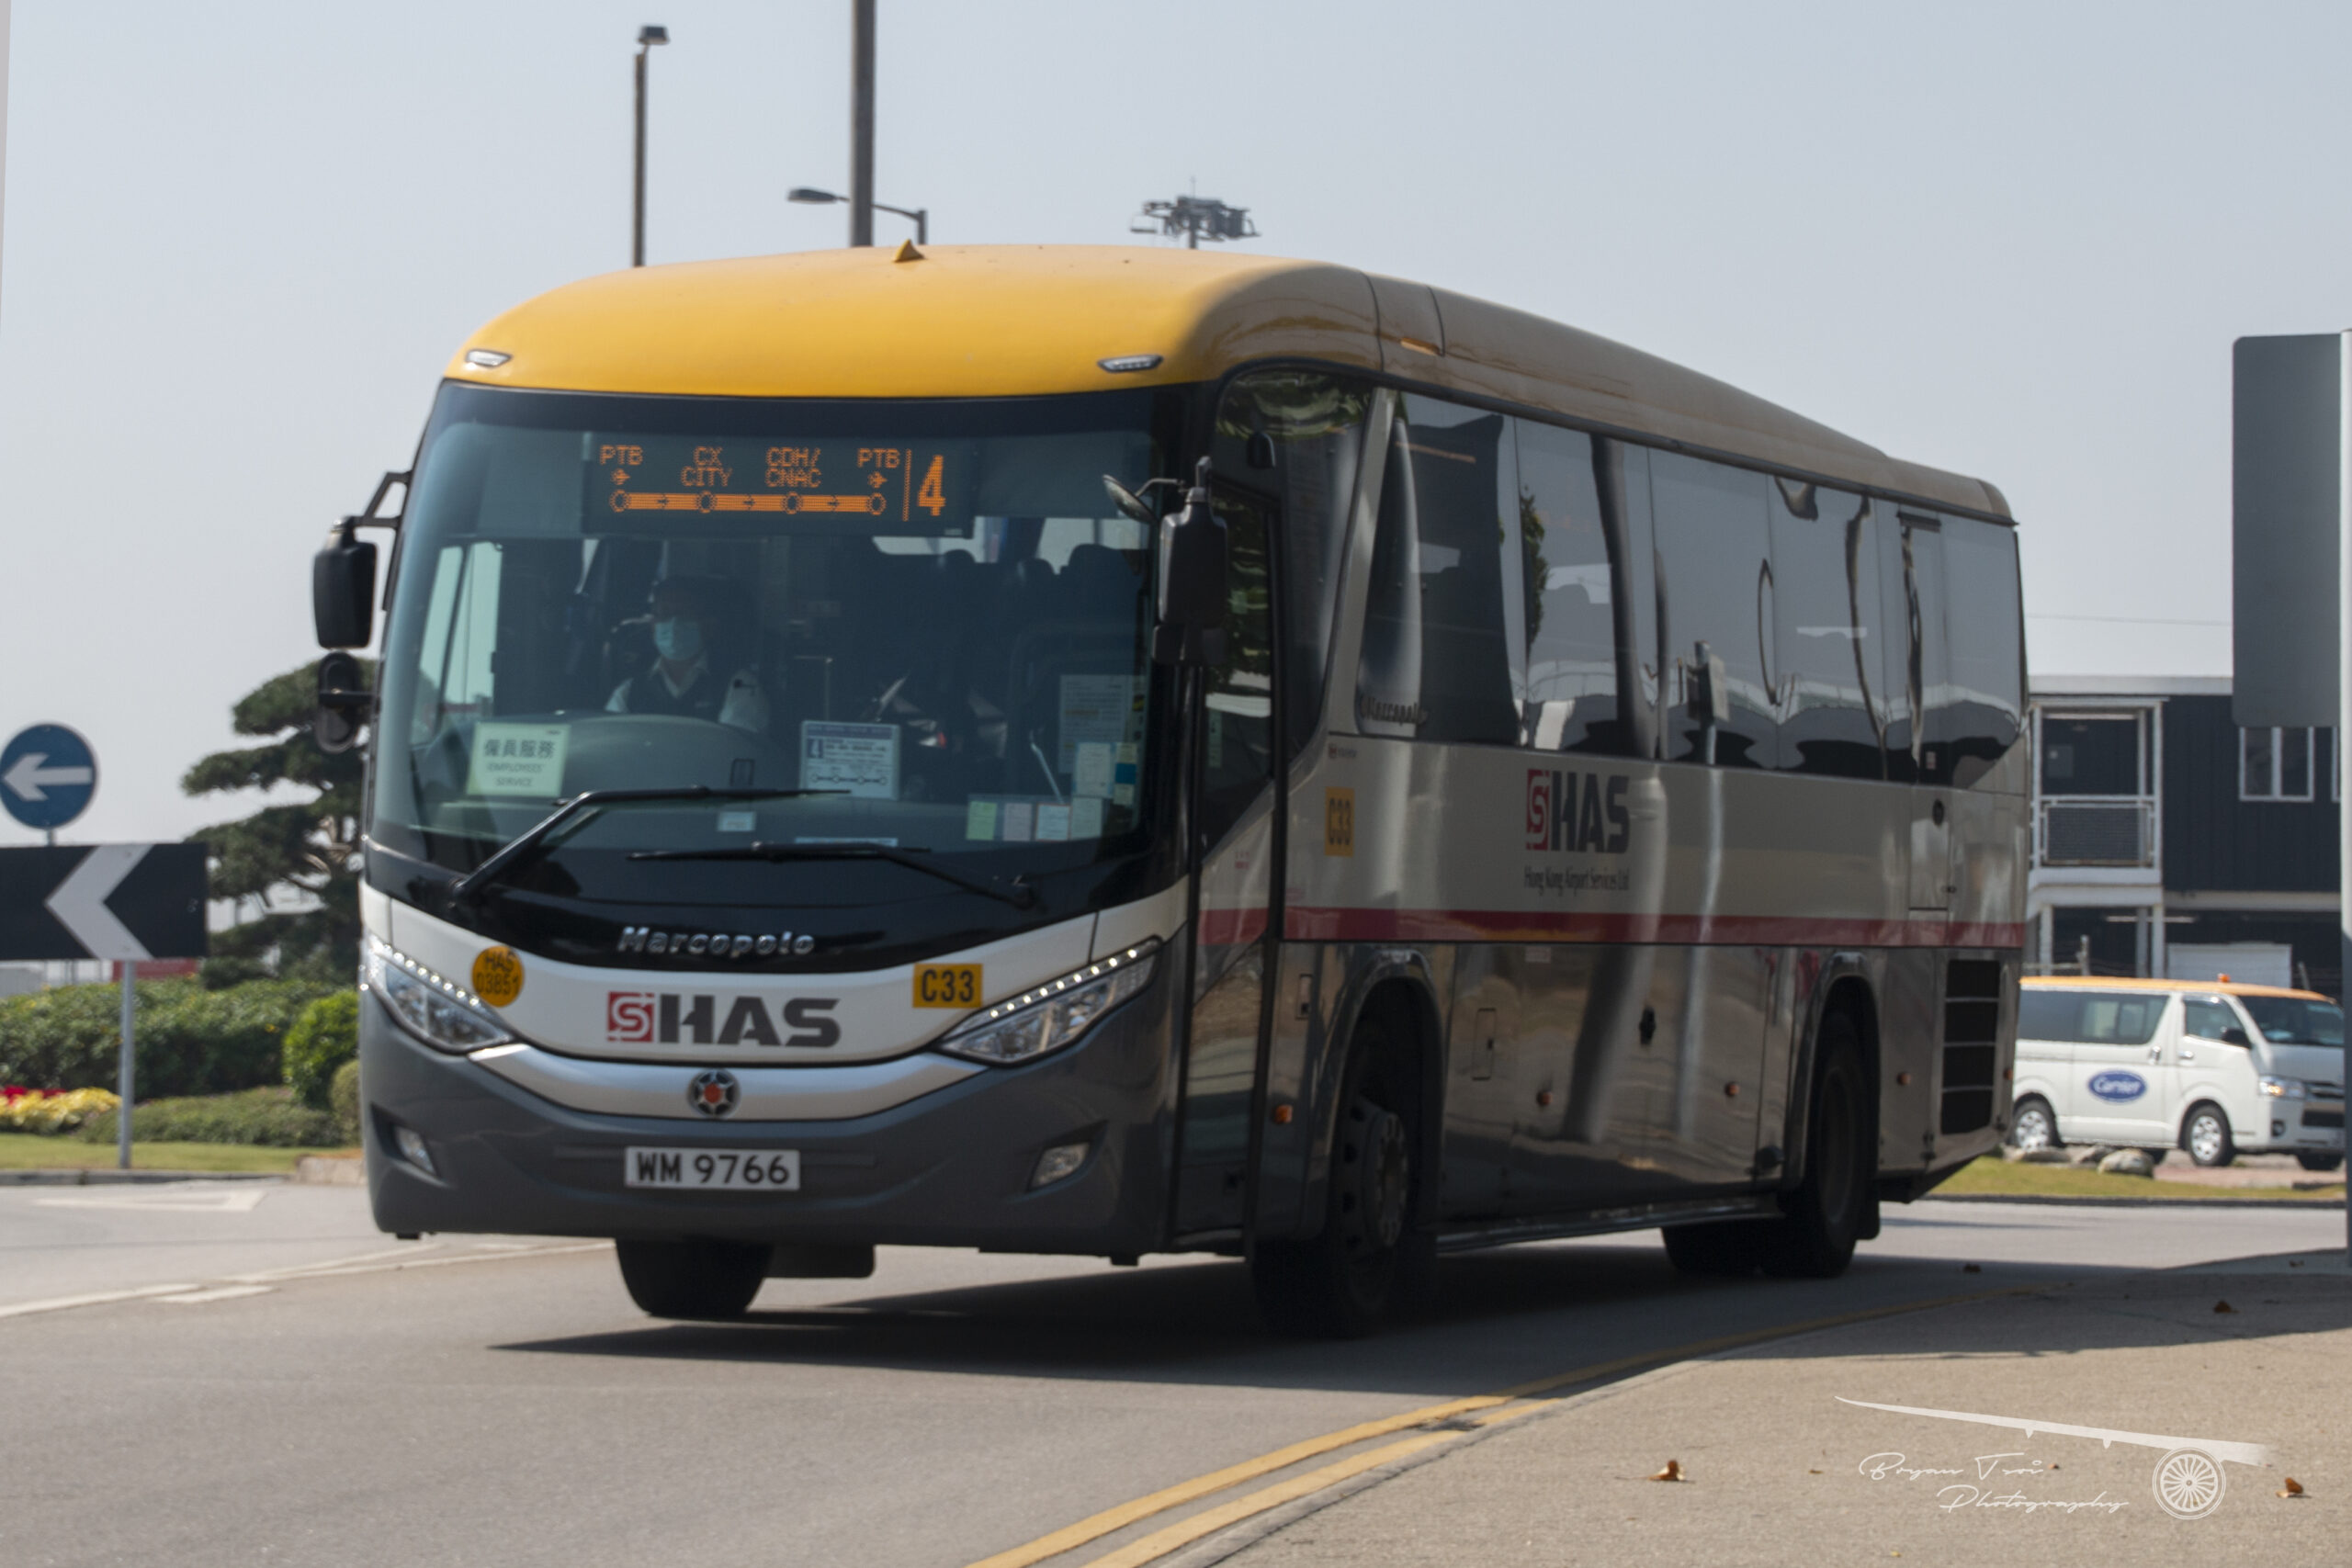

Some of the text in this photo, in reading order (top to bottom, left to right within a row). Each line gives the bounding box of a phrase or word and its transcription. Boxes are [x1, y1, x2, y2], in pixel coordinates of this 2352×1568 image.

[599, 445, 643, 466] PTB
[693, 446, 723, 466] CX
[856, 447, 901, 469] PTB
[681, 466, 732, 488] CITY
[764, 467, 822, 489] CNAC
[917, 455, 946, 517] 4
[616, 926, 815, 958] Marcopolo
[484, 951, 515, 973] HAS
[921, 969, 975, 1003] C33
[636, 1152, 790, 1184] WM 9766
